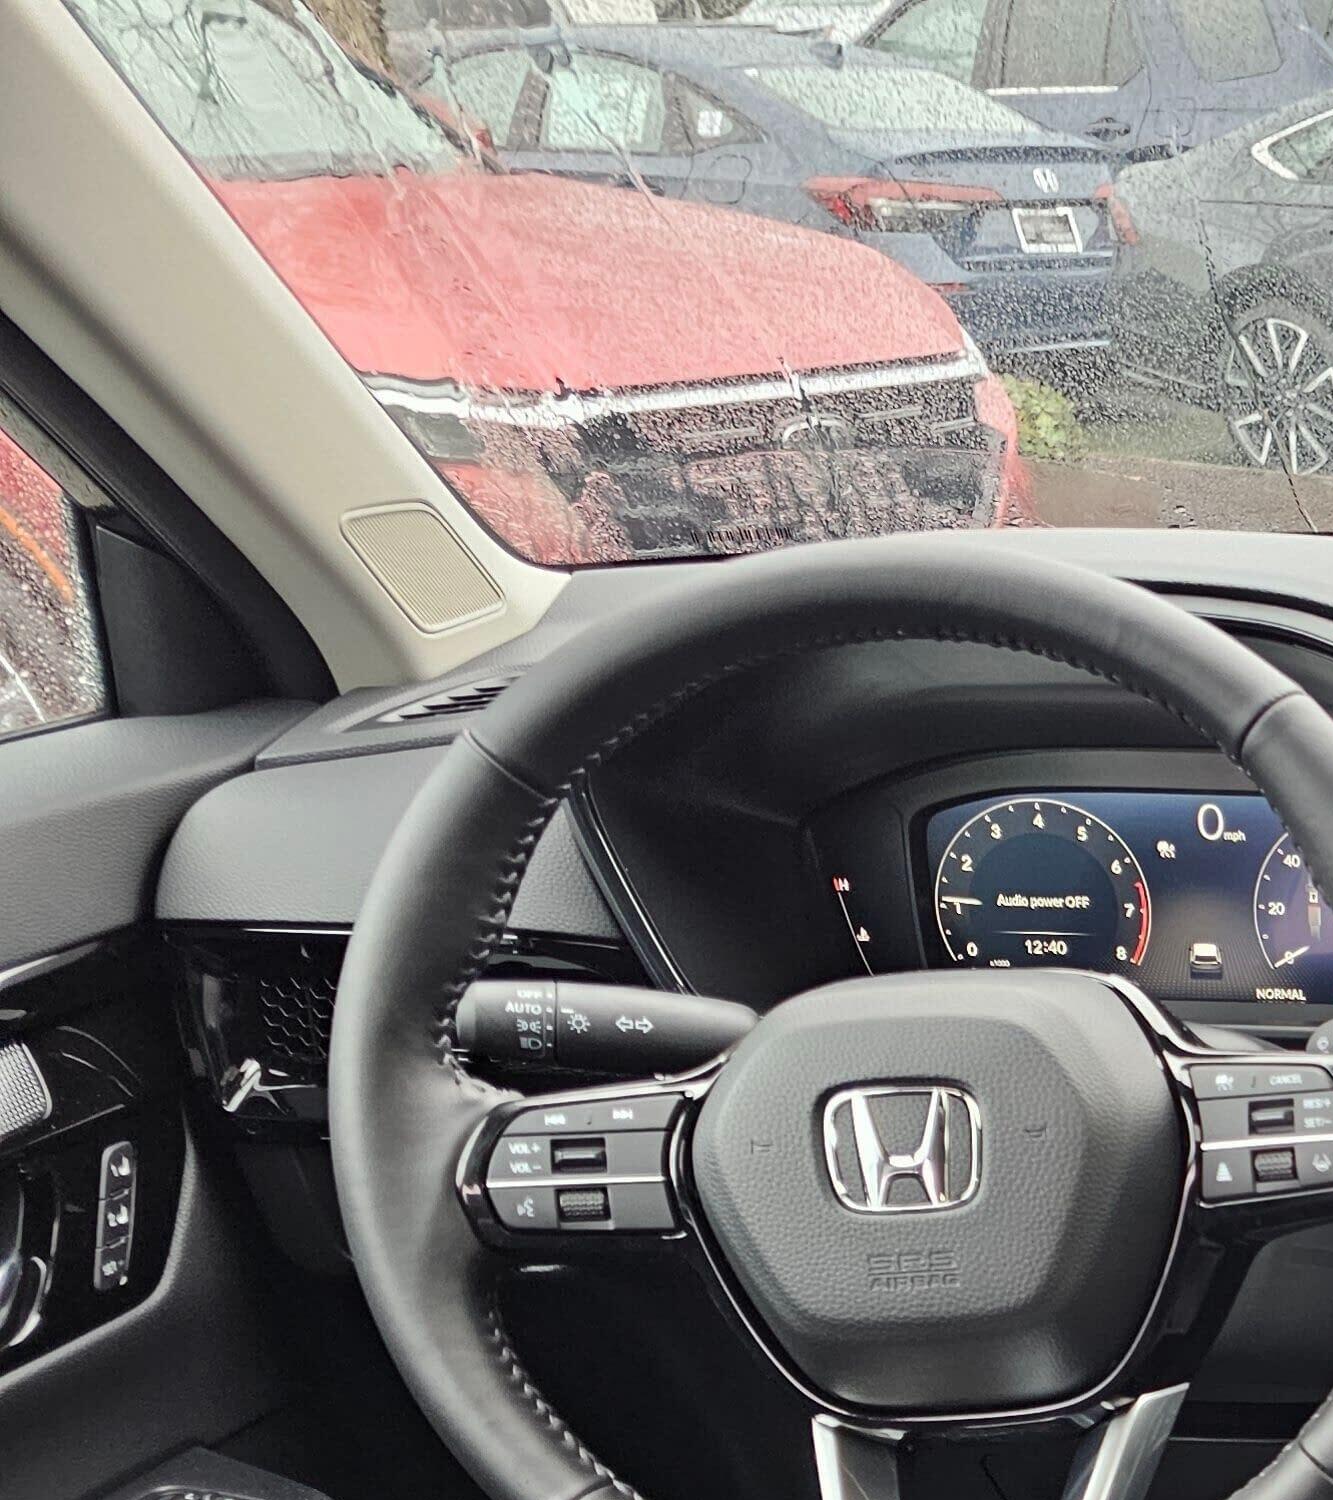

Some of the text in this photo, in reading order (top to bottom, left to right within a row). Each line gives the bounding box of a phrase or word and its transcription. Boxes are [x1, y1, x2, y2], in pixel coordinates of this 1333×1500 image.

[1032, 813, 1046, 829] 4
[1197, 803, 1246, 842] 0 mph
[990, 823, 1002, 839] 3
[1076, 826, 1089, 842] 5
[961, 854, 974, 872] 2
[1111, 859, 1123, 875] 6
[1283, 854, 1301, 868] 40
[996, 893, 1090, 910] Audio power OFF
[1268, 902, 1286, 916] 20
[1124, 903, 1136, 918] 7
[966, 941, 978, 957] 0
[1025, 939, 1068, 956] 12:40
[1115, 946, 1127, 961] 8
[1256, 988, 1307, 1001] NORMAL
[505, 1001, 542, 1015] AUTO
[866, 1250, 957, 1271] SRS
